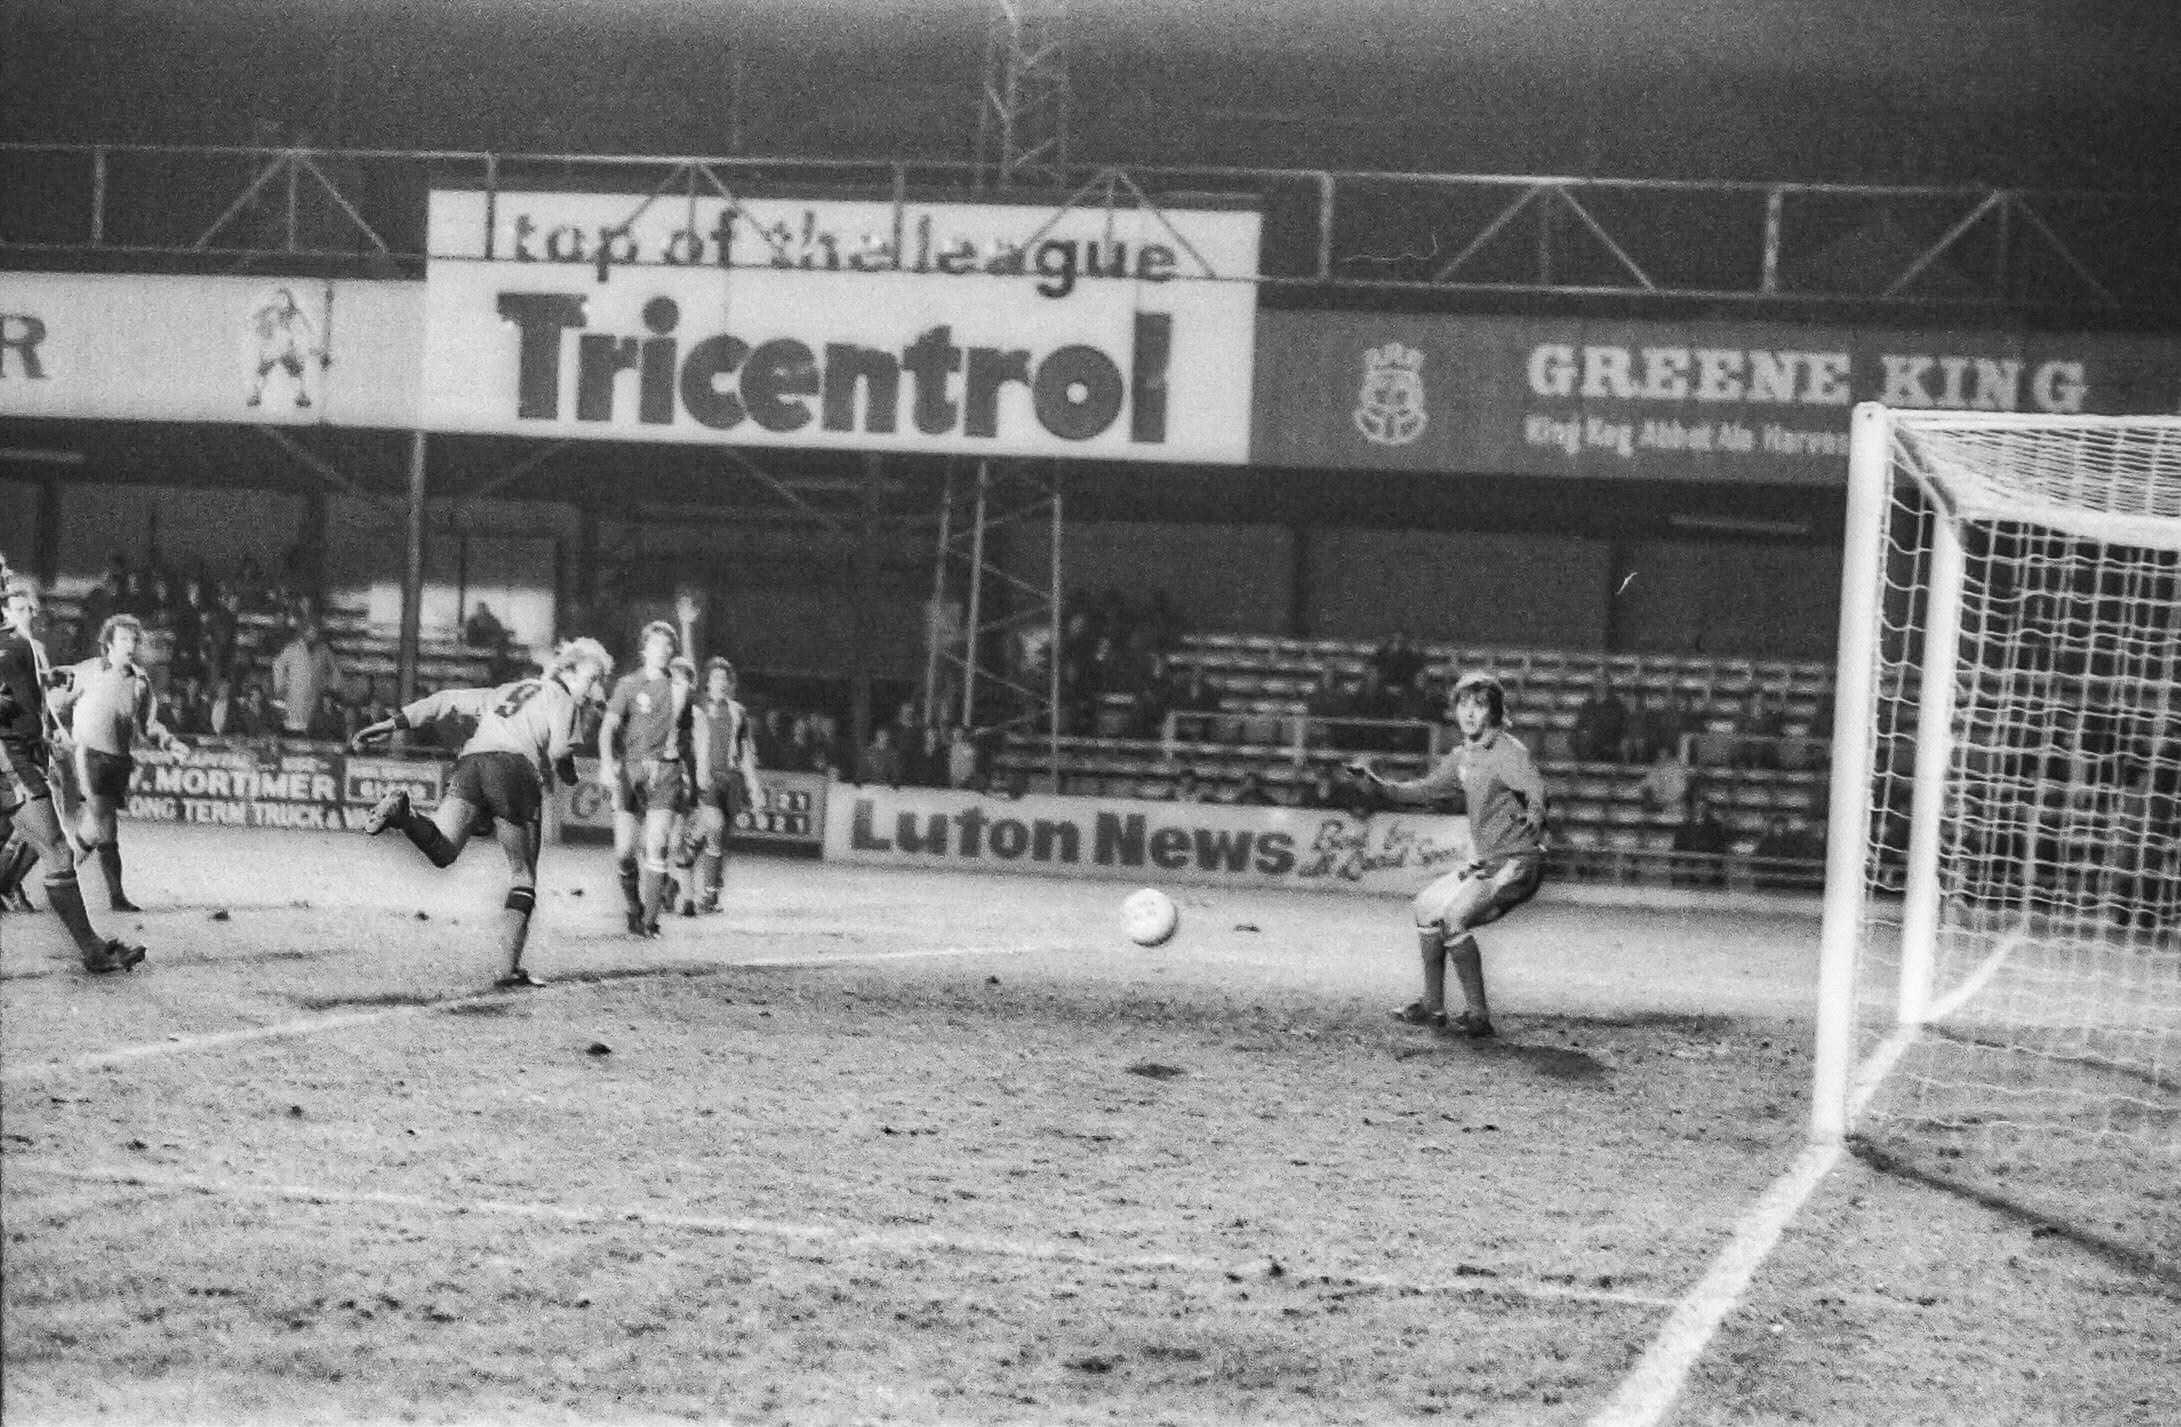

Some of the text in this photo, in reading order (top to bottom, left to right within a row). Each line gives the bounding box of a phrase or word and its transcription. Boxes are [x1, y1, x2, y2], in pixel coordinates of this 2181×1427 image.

[663, 205, 741, 268] of
[766, 210, 898, 271] the
[916, 214, 1179, 298] league
[496, 291, 1171, 443] Tricentrol
[1527, 344, 2088, 412] GREENE KING
[154, 764, 338, 800] MORTIMER
[183, 797, 247, 825] TERM
[251, 800, 325, 830] TRUCK
[851, 797, 1296, 877] Luton News
